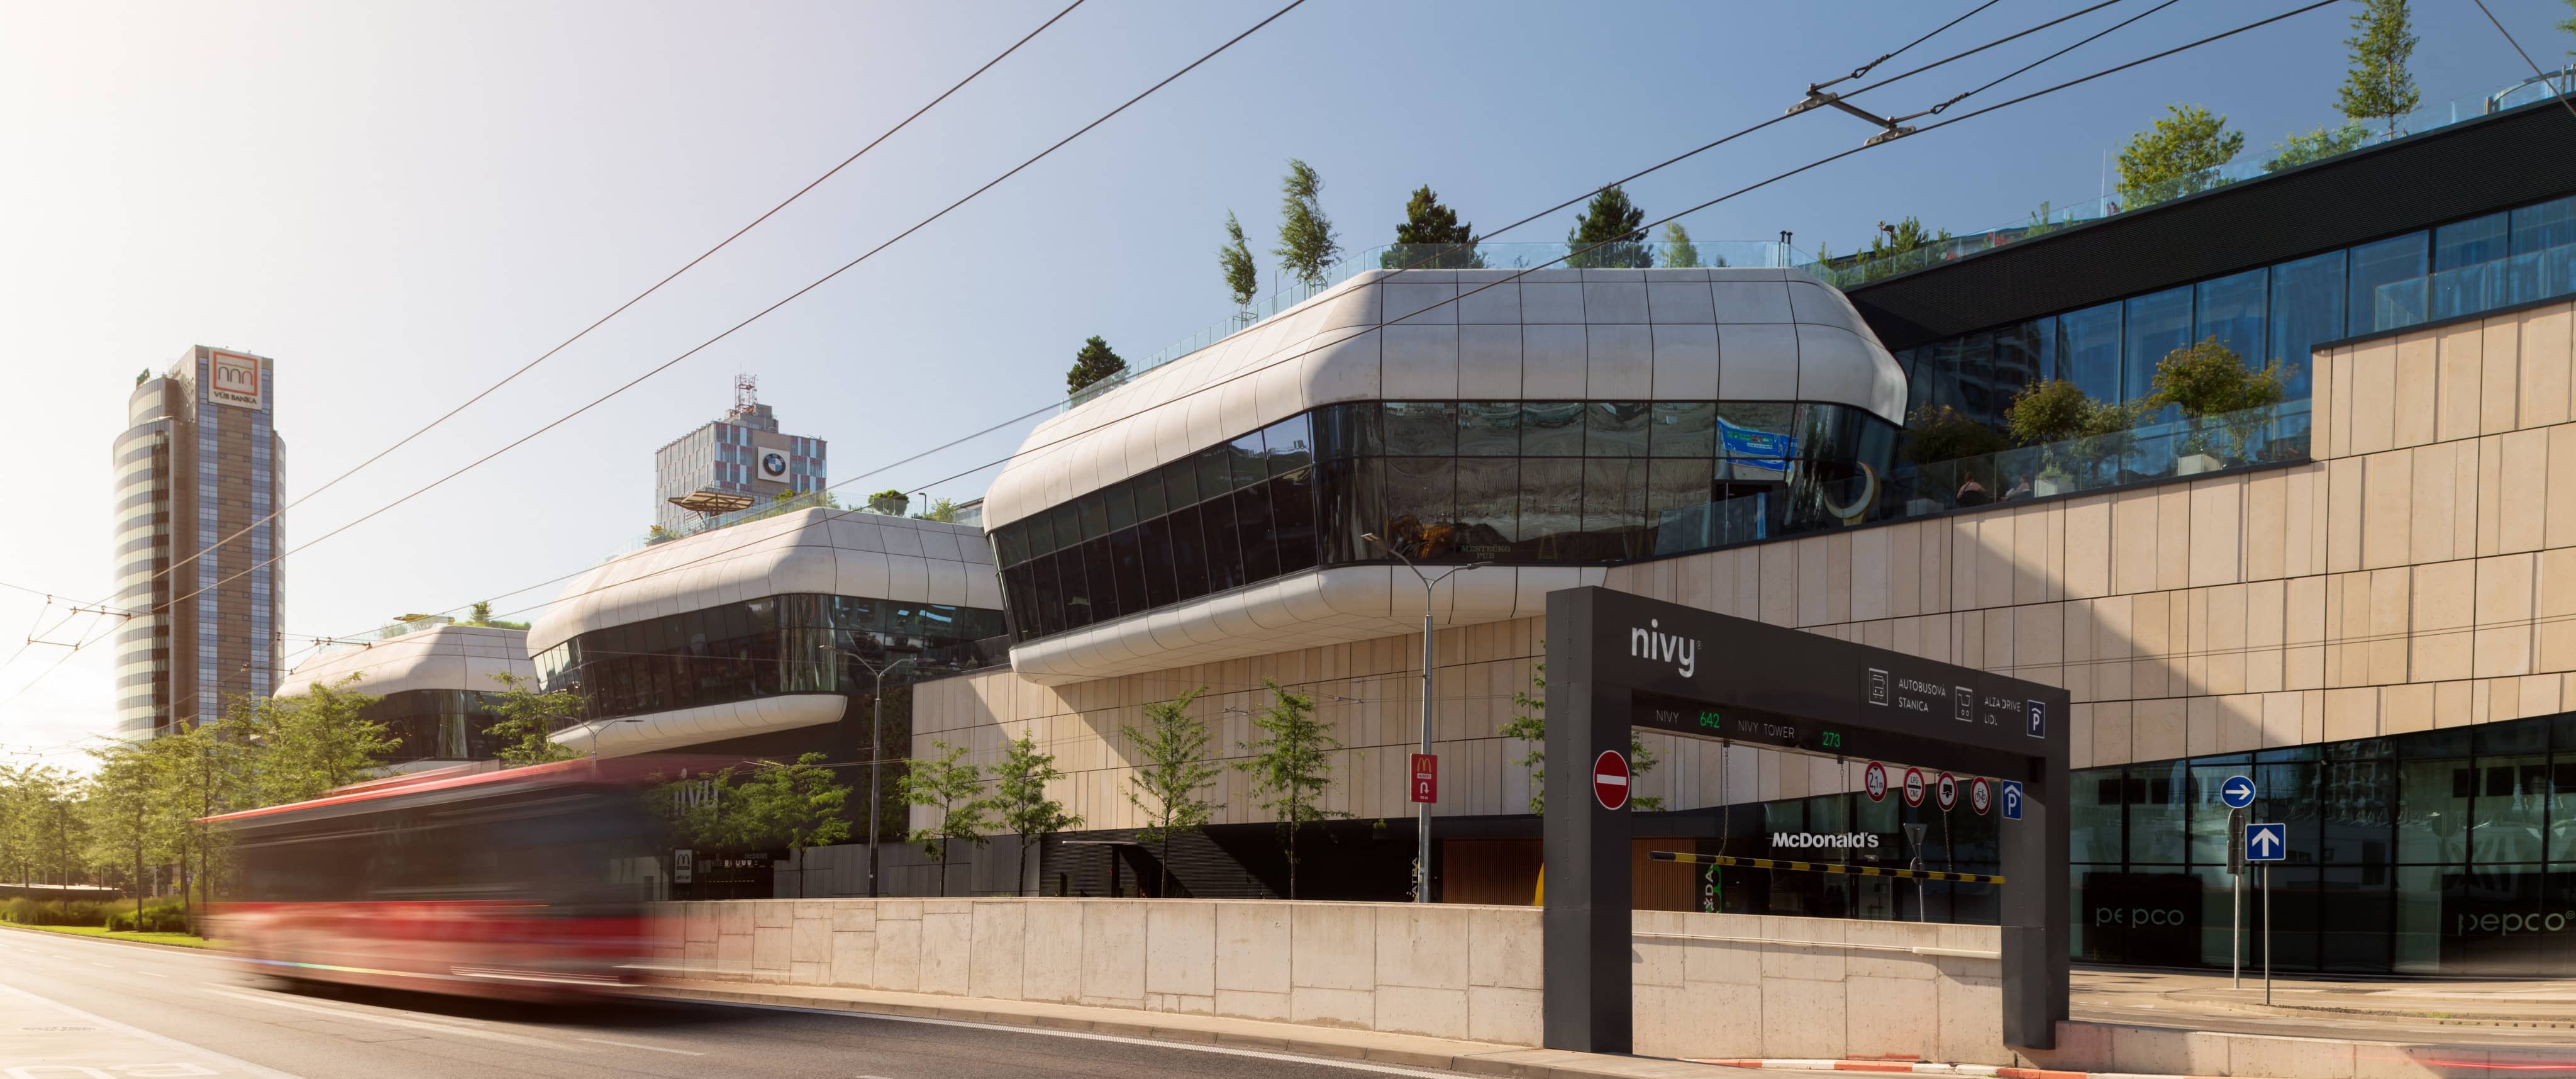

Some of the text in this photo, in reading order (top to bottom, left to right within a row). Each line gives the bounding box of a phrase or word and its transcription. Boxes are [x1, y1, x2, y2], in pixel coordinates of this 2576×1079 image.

[231, 394, 257, 405] BANKA
[1631, 618, 1695, 678] nivy
[1898, 679, 1946, 696] AUTOBUSOVÁ
[1898, 696, 1929, 712] STANICA
[1984, 696, 2021, 712] ALZA DRIVE
[1984, 714, 1998, 725] LIDL
[1656, 710, 1841, 747] NIVY 642 NIVY TOWER 273
[1869, 772, 1879, 791] 2,1
[1910, 776, 1919, 784] LPG
[1910, 790, 1919, 798] CNG
[1772, 832, 1879, 848] McDonald's
[2096, 907, 2184, 928] pepco
